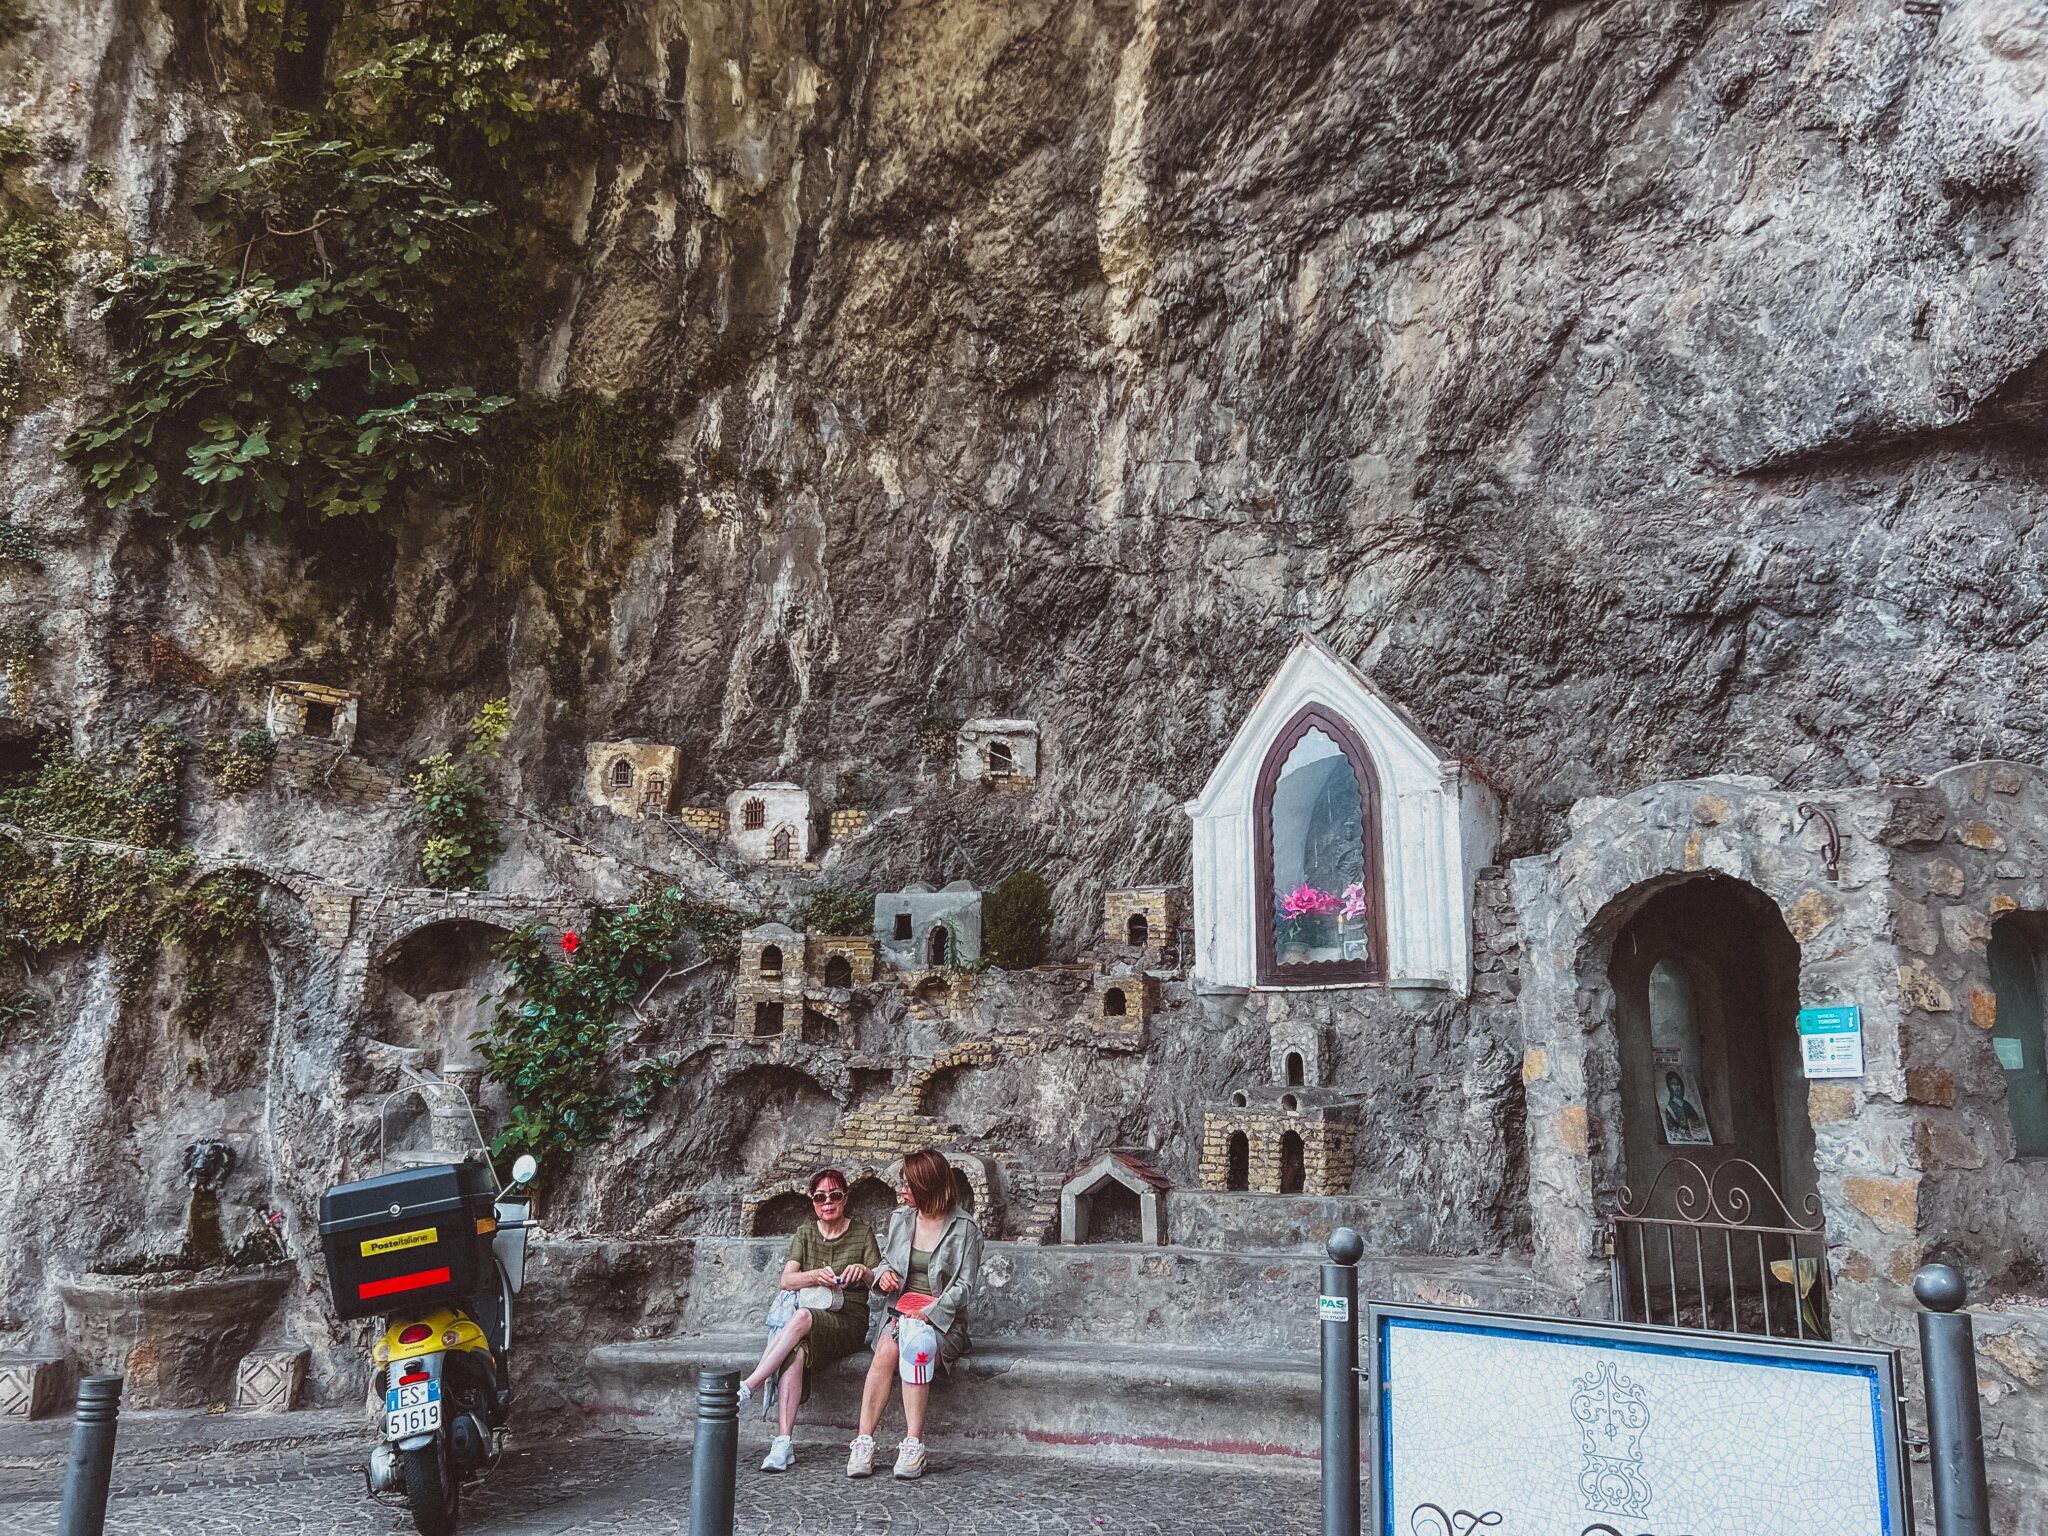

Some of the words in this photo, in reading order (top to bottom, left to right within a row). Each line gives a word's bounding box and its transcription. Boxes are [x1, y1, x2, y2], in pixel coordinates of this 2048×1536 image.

[1321, 1298, 1344, 1308] PAS
[400, 1386, 419, 1407] ES
[391, 1405, 438, 1434] 51619
